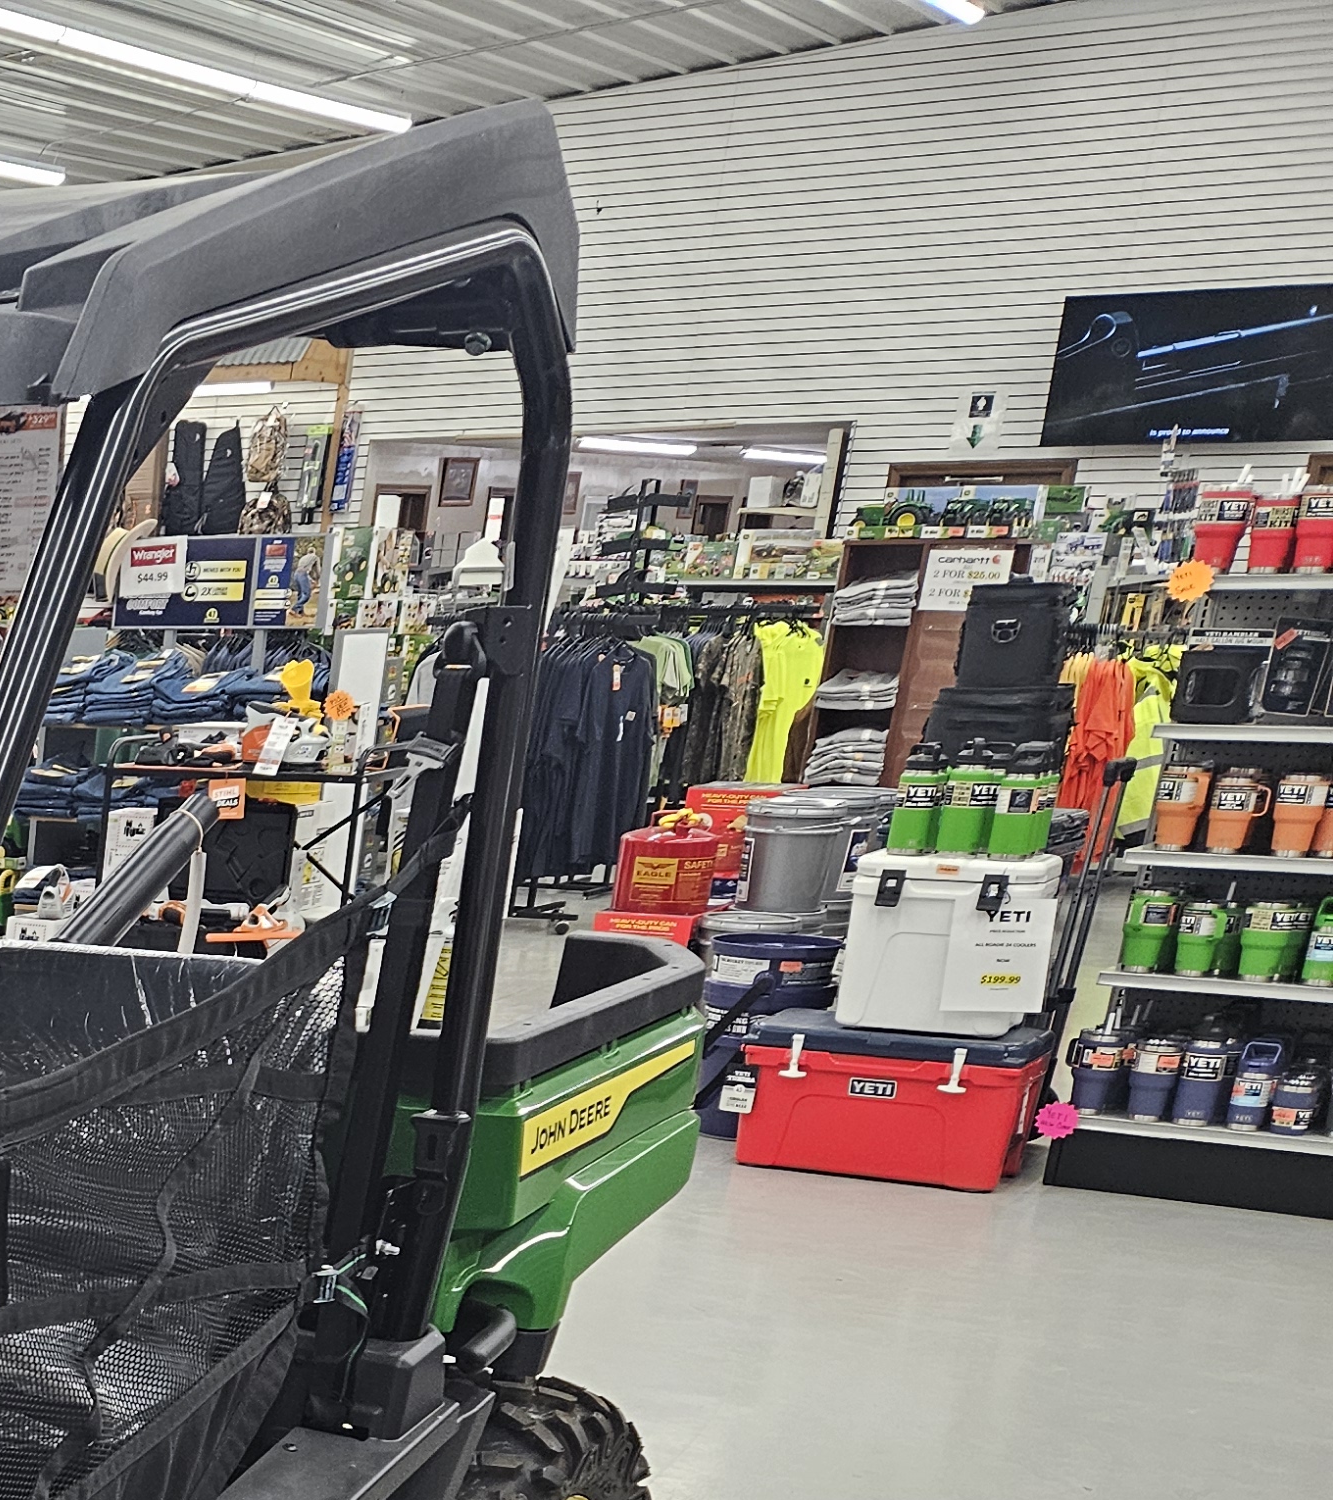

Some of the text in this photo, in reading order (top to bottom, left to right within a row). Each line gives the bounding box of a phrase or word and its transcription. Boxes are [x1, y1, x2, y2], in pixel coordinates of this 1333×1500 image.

[1223, 501, 1247, 511] YETI
[1309, 497, 1333, 508] YET
[1269, 519, 1291, 528] KIT
[133, 547, 176, 564] Wrangler
[938, 556, 990, 564] carhartt
[137, 571, 168, 584] $44.99
[933, 570, 1001, 579] 2 FOR $25.00
[938, 588, 961, 597] FOR
[214, 788, 238, 798] STIHL
[908, 786, 937, 797] YETI
[1279, 784, 1307, 795] YETI
[1220, 792, 1246, 802] YETI
[217, 798, 239, 807] DEALS
[684, 860, 713, 870] SAFETY
[636, 870, 672, 878] EAGLE
[985, 910, 1031, 922] YETI
[980, 975, 1021, 985] $199.99
[1190, 1056, 1220, 1070] YETI
[852, 1080, 893, 1095] YETI
[1239, 1081, 1262, 1090] YETI
[531, 1095, 612, 1155] JOHN DEERE
